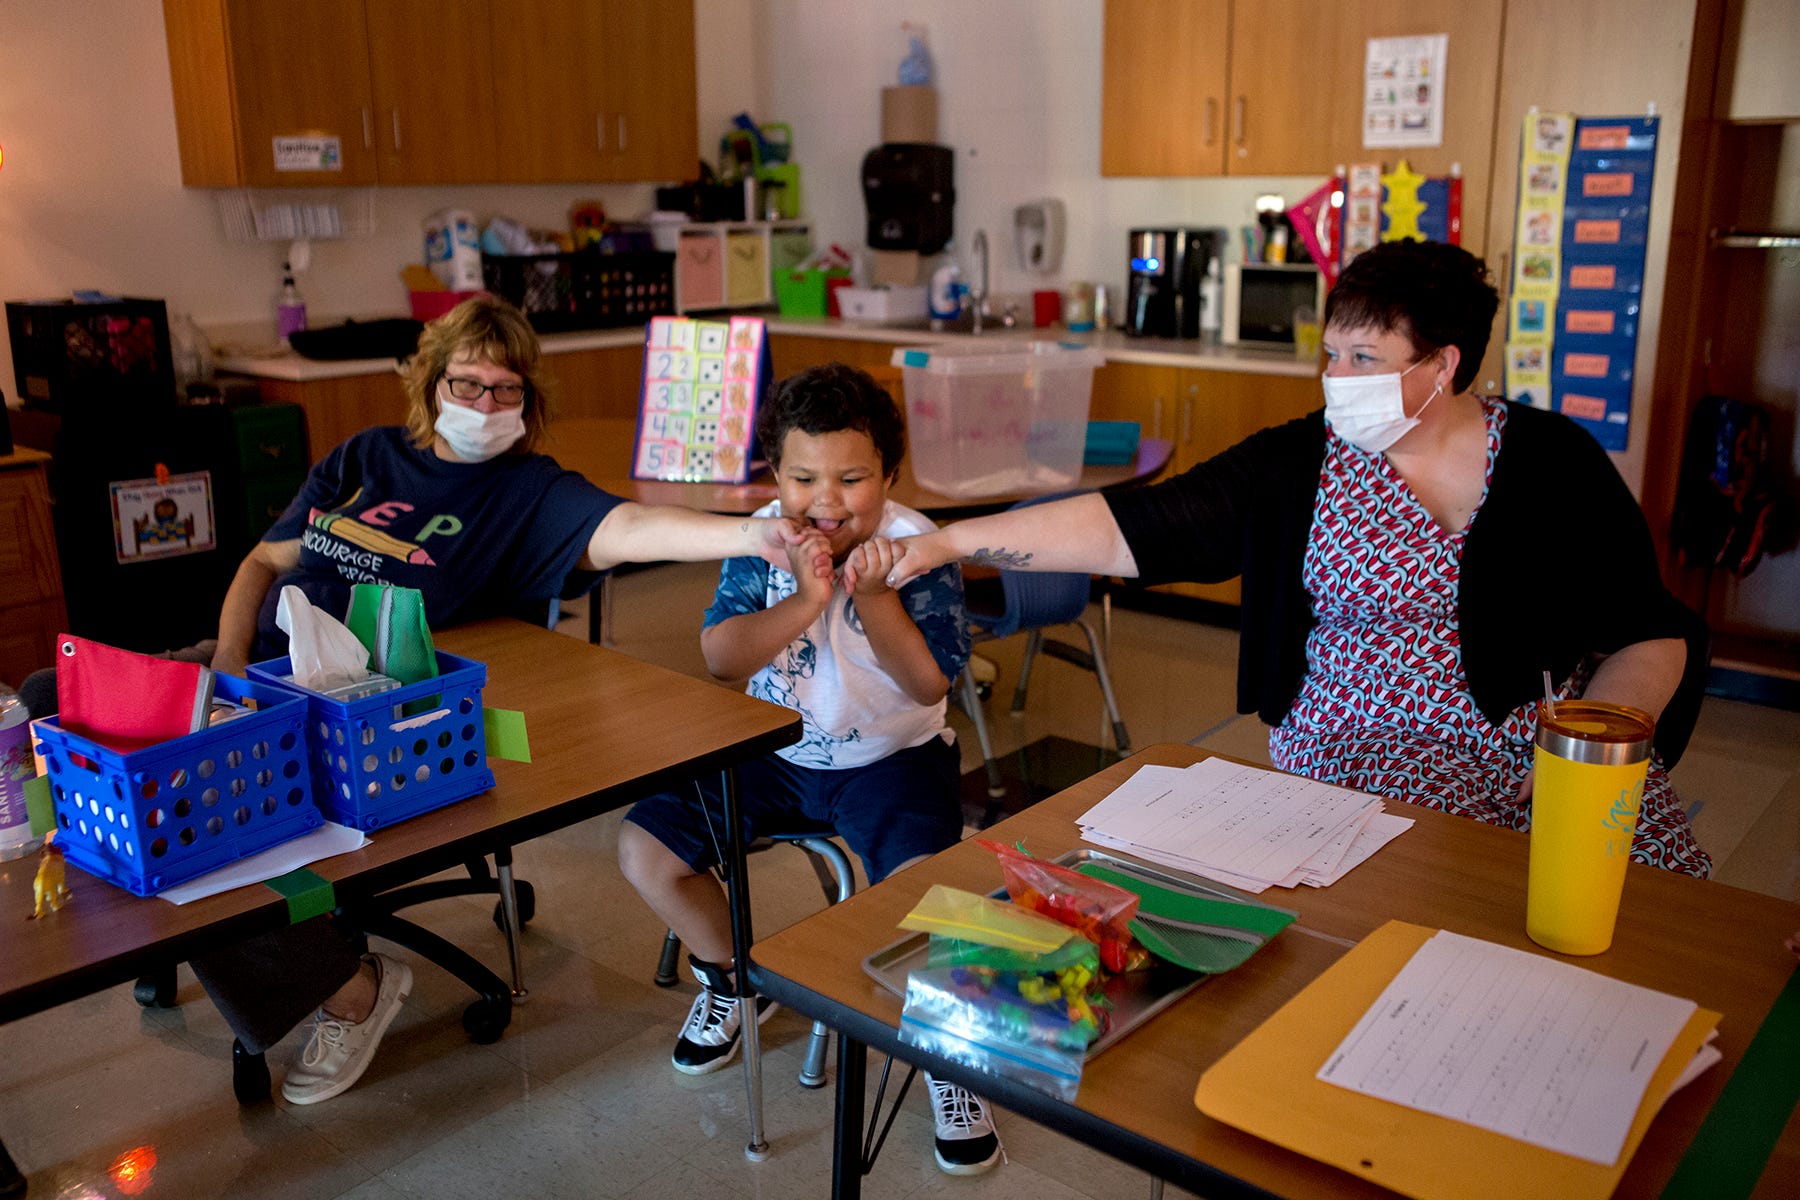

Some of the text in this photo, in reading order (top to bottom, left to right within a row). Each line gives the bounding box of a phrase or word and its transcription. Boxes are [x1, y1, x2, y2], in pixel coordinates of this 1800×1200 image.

[658, 354, 689, 378] 2 2
[656, 386, 670, 410] 3
[653, 415, 685, 438] 4 4
[648, 444, 676, 470] 5 5
[301, 529, 384, 572] NCOURAGE
